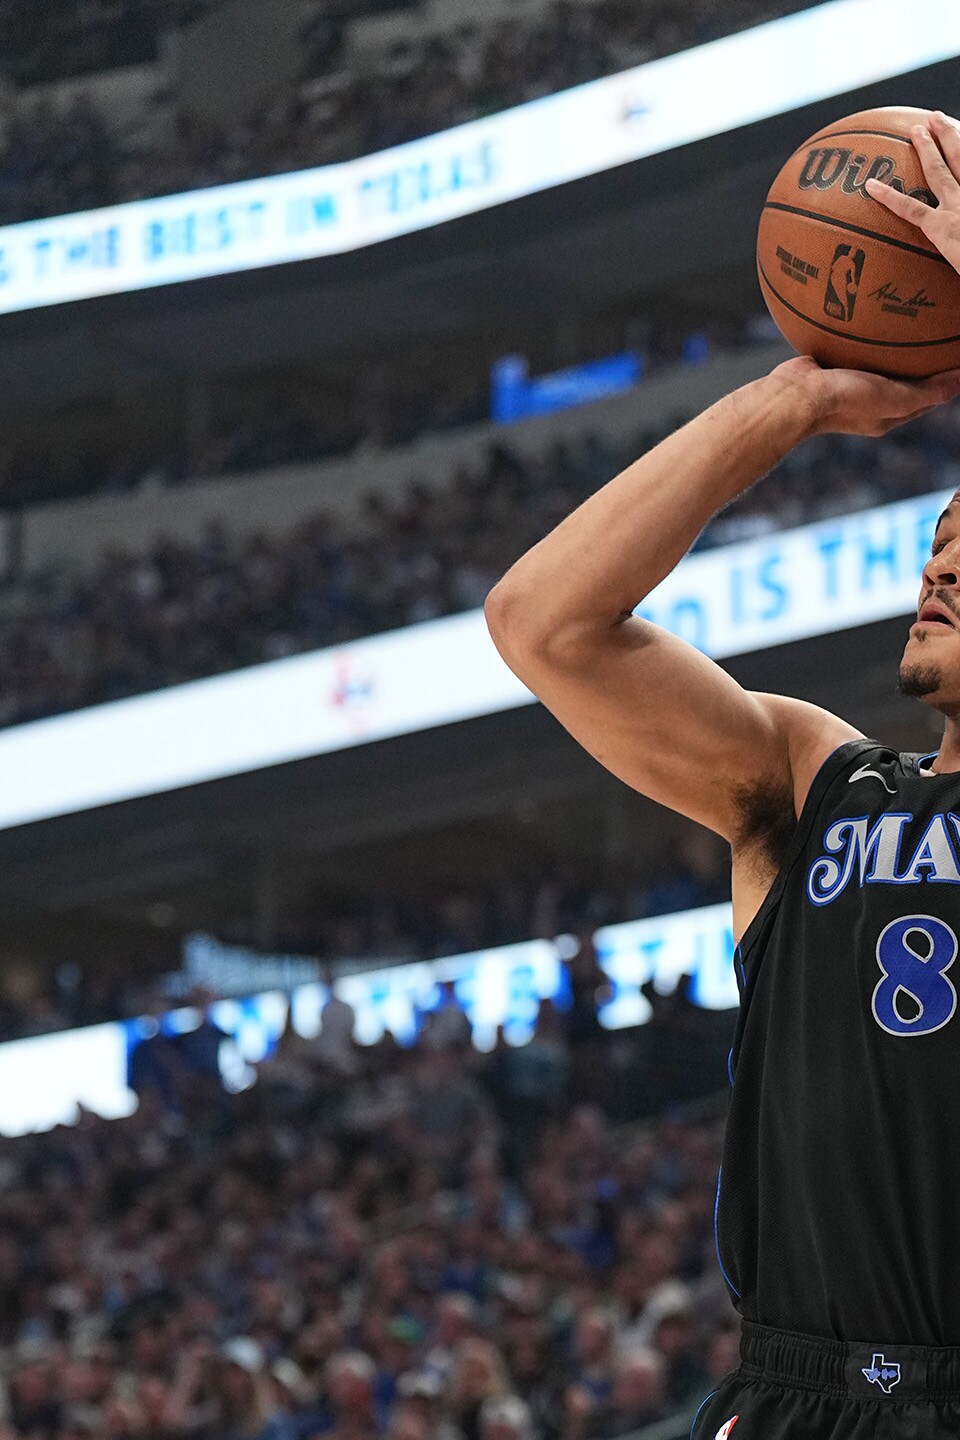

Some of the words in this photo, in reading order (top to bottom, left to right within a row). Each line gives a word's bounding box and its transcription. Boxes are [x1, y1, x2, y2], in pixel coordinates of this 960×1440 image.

[797, 147, 940, 209] Wil
[143, 200, 266, 260] BEST
[730, 554, 788, 624] IS
[871, 914, 959, 1037] 8
